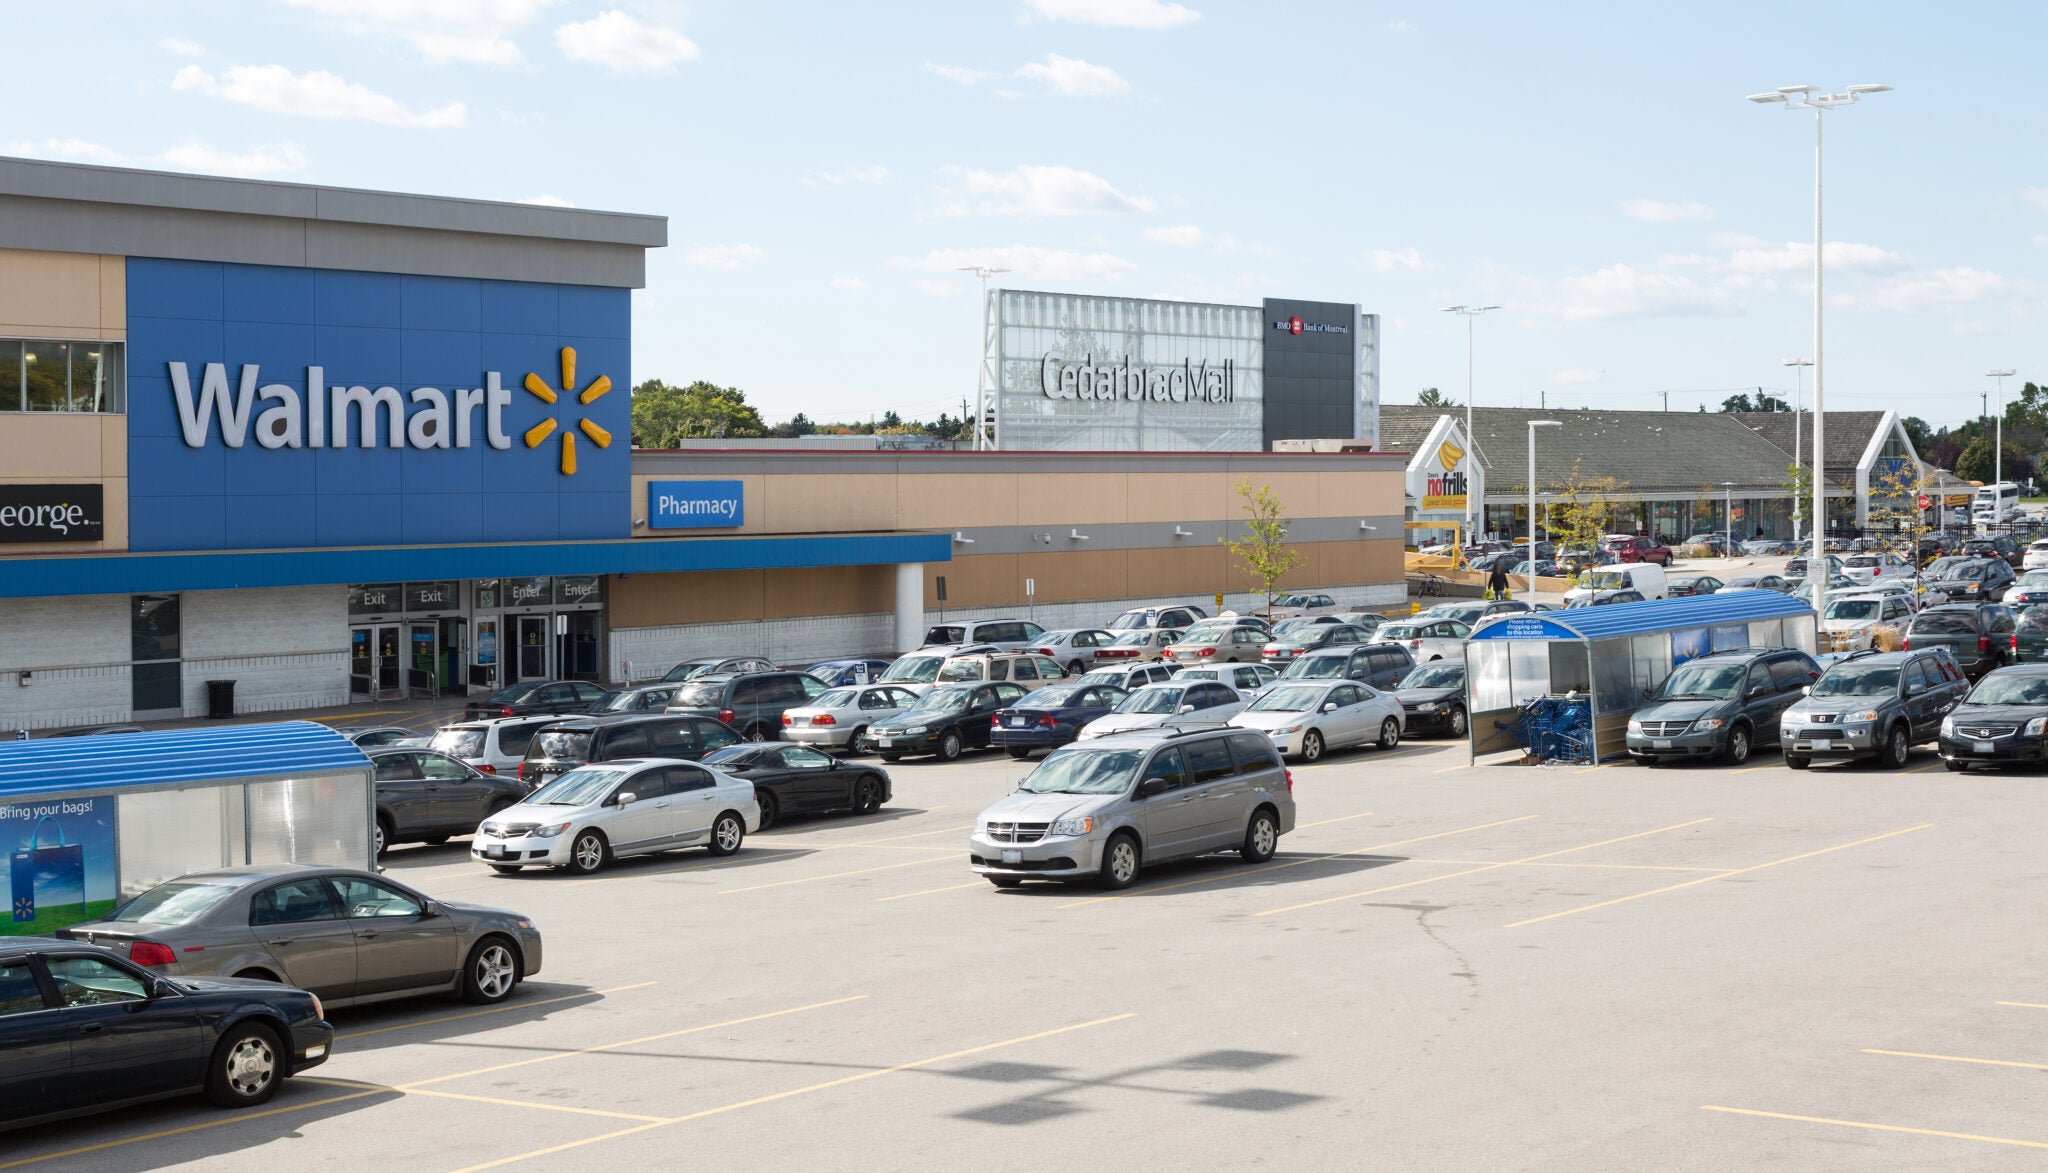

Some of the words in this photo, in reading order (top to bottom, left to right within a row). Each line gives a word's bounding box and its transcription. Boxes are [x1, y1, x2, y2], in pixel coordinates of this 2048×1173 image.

[1277, 321, 1291, 330] BMO
[1303, 323, 1317, 332] Bank
[1317, 324, 1323, 332] of
[1324, 324, 1347, 334] Montreal
[168, 361, 512, 450] Walmart
[659, 494, 738, 519] Pharmacy
[512, 585, 541, 598] Enter
[565, 583, 592, 596] Enter
[364, 592, 386, 606] Exit
[421, 590, 442, 603] Exit
[0, 806, 31, 820] Bring
[33, 805, 60, 819] your
[62, 799, 93, 815] bags!
